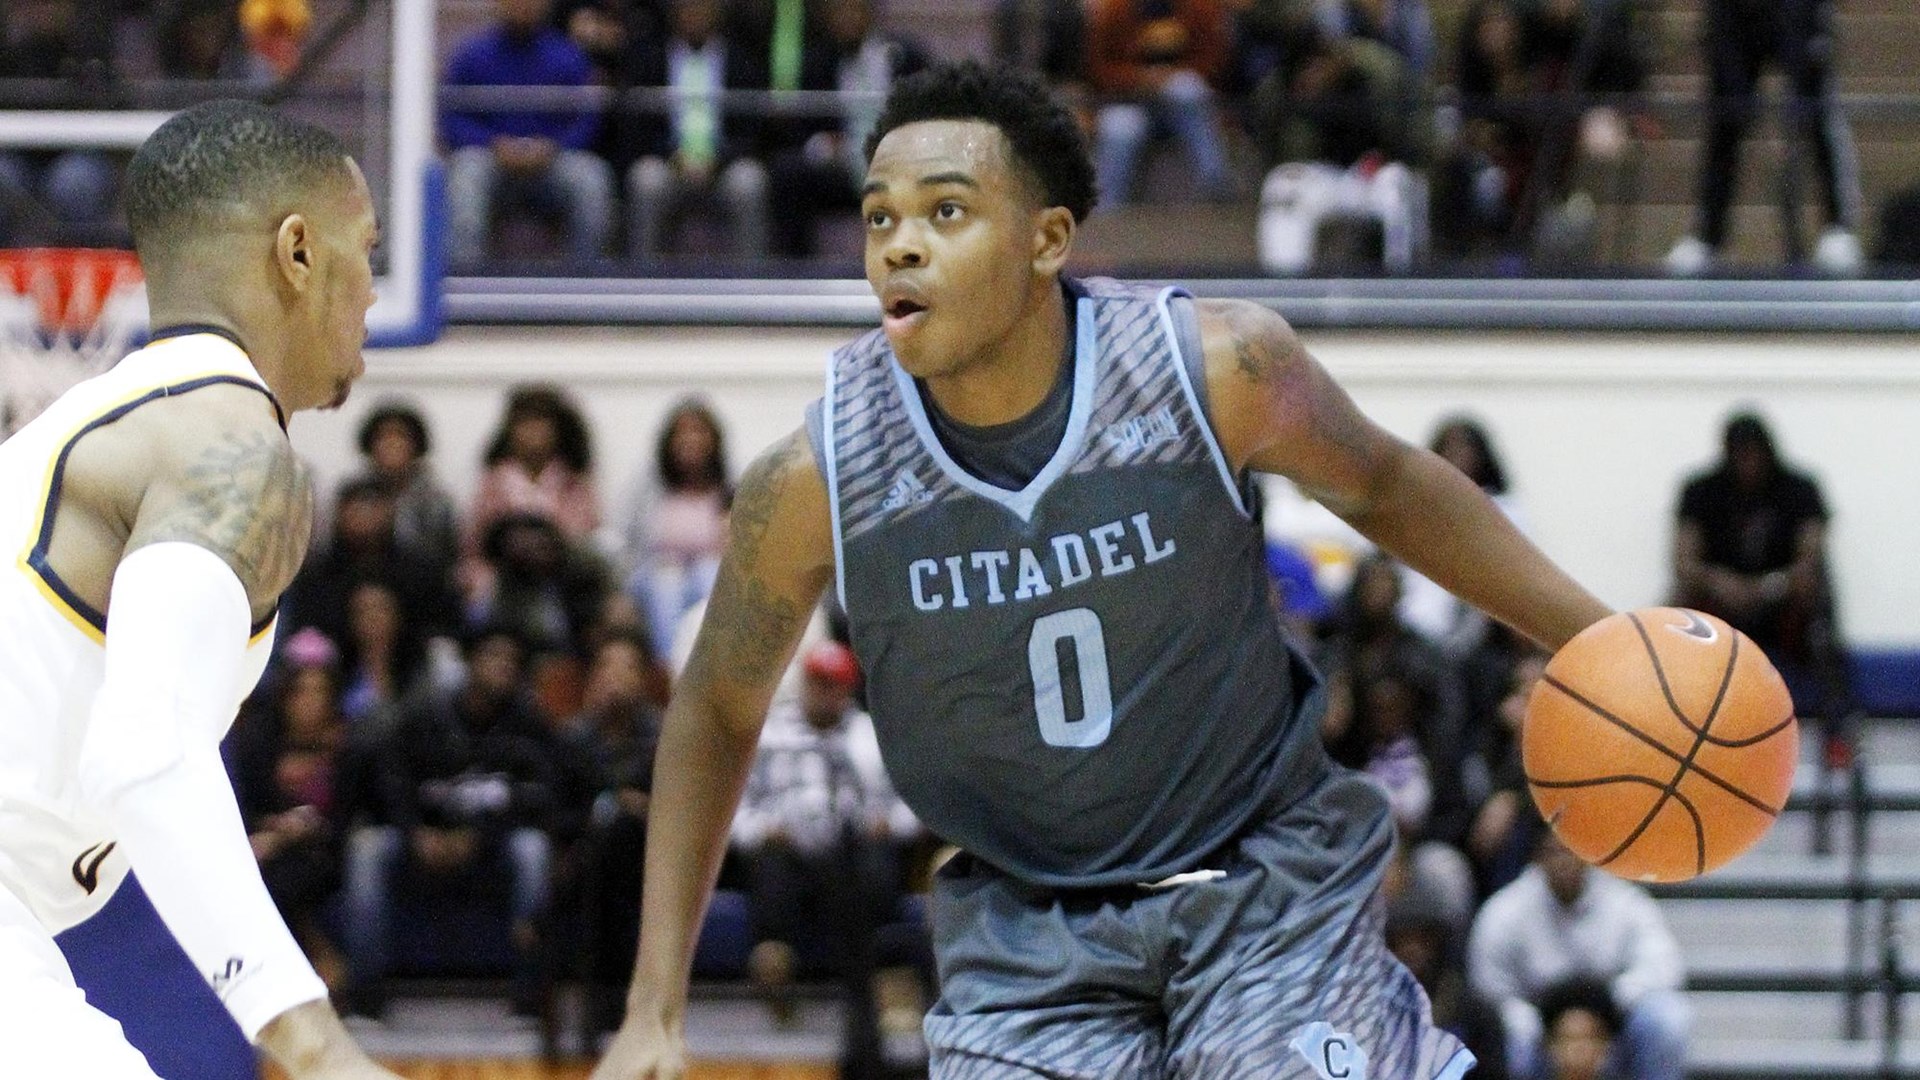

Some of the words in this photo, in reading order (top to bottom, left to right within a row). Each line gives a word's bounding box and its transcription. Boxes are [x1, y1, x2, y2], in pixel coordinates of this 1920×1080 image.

[909, 511, 1176, 611] CITADEL
[1028, 607, 1113, 748] 0
[1323, 1037, 1350, 1079] C
